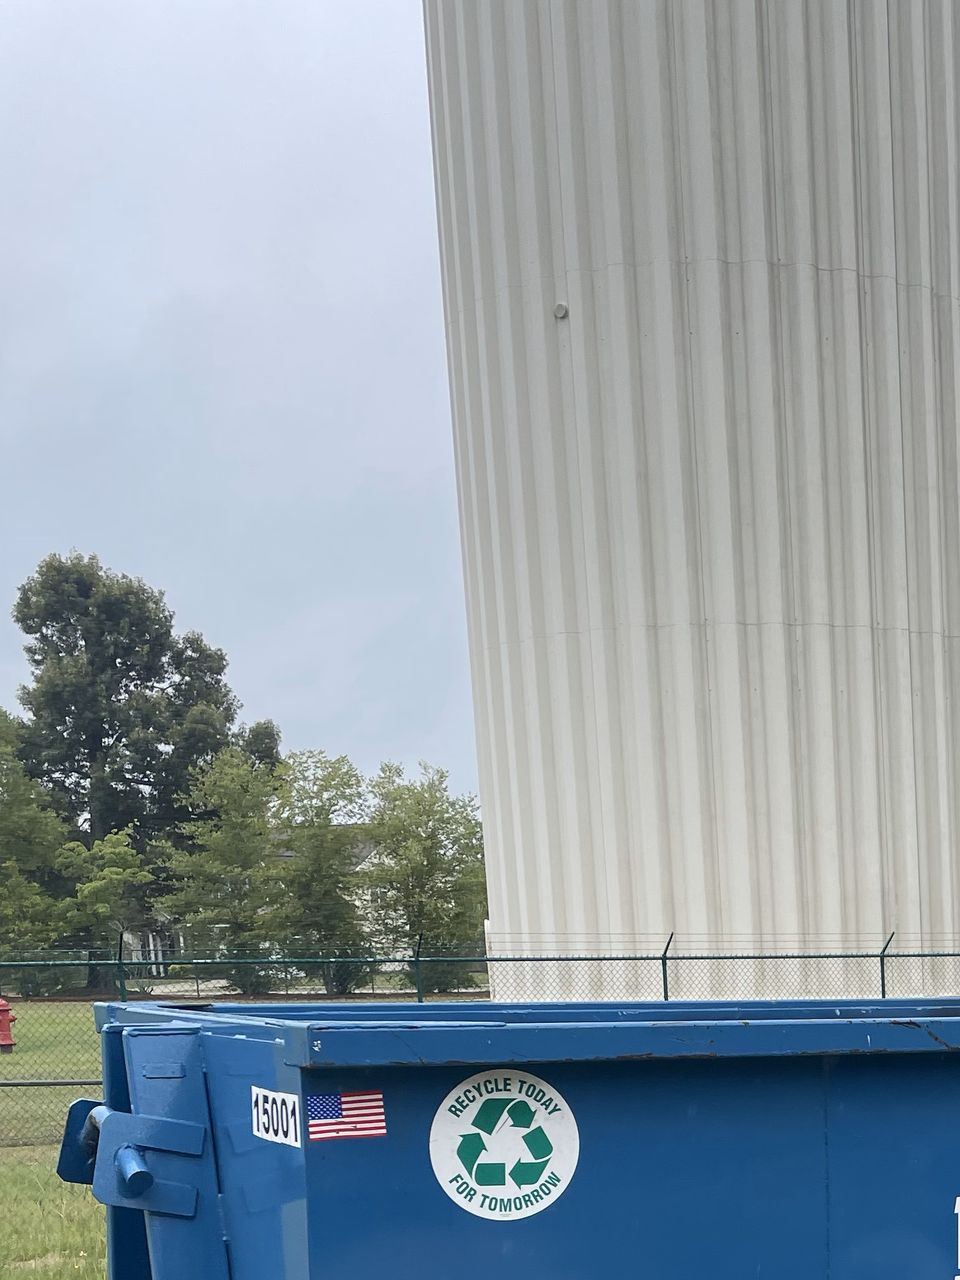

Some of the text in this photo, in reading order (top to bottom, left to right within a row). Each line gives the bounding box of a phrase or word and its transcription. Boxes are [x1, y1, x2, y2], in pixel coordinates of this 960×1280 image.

[253, 1093, 299, 1143] 15001
[448, 1078, 562, 1118] RECYCLE TODAY
[448, 1171, 562, 1212] FOR TOMORROW
